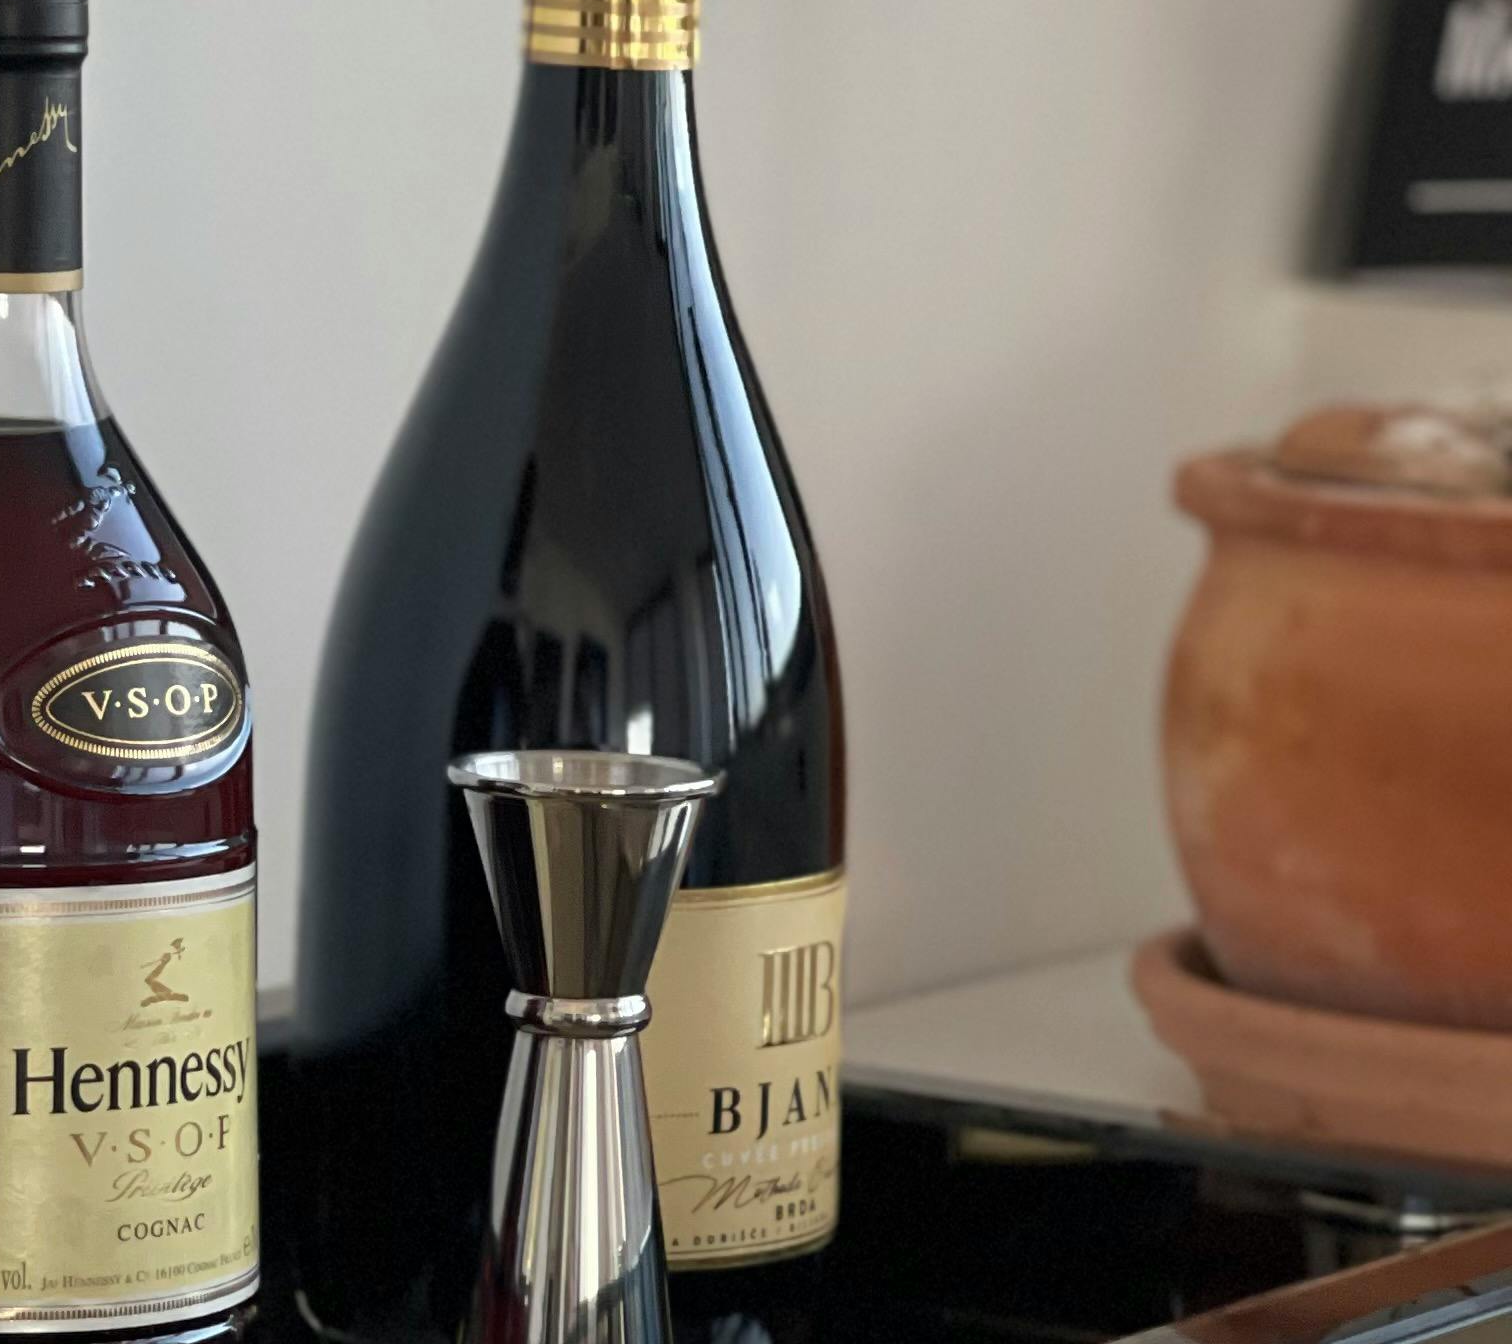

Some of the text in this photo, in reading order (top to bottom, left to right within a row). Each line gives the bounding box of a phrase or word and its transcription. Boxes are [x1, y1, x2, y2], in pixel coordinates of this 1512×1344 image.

[12, 1037, 250, 1116] Hennessy
[116, 1212, 205, 1242] COGNAC
[0, 1260, 32, 1291] vol.
